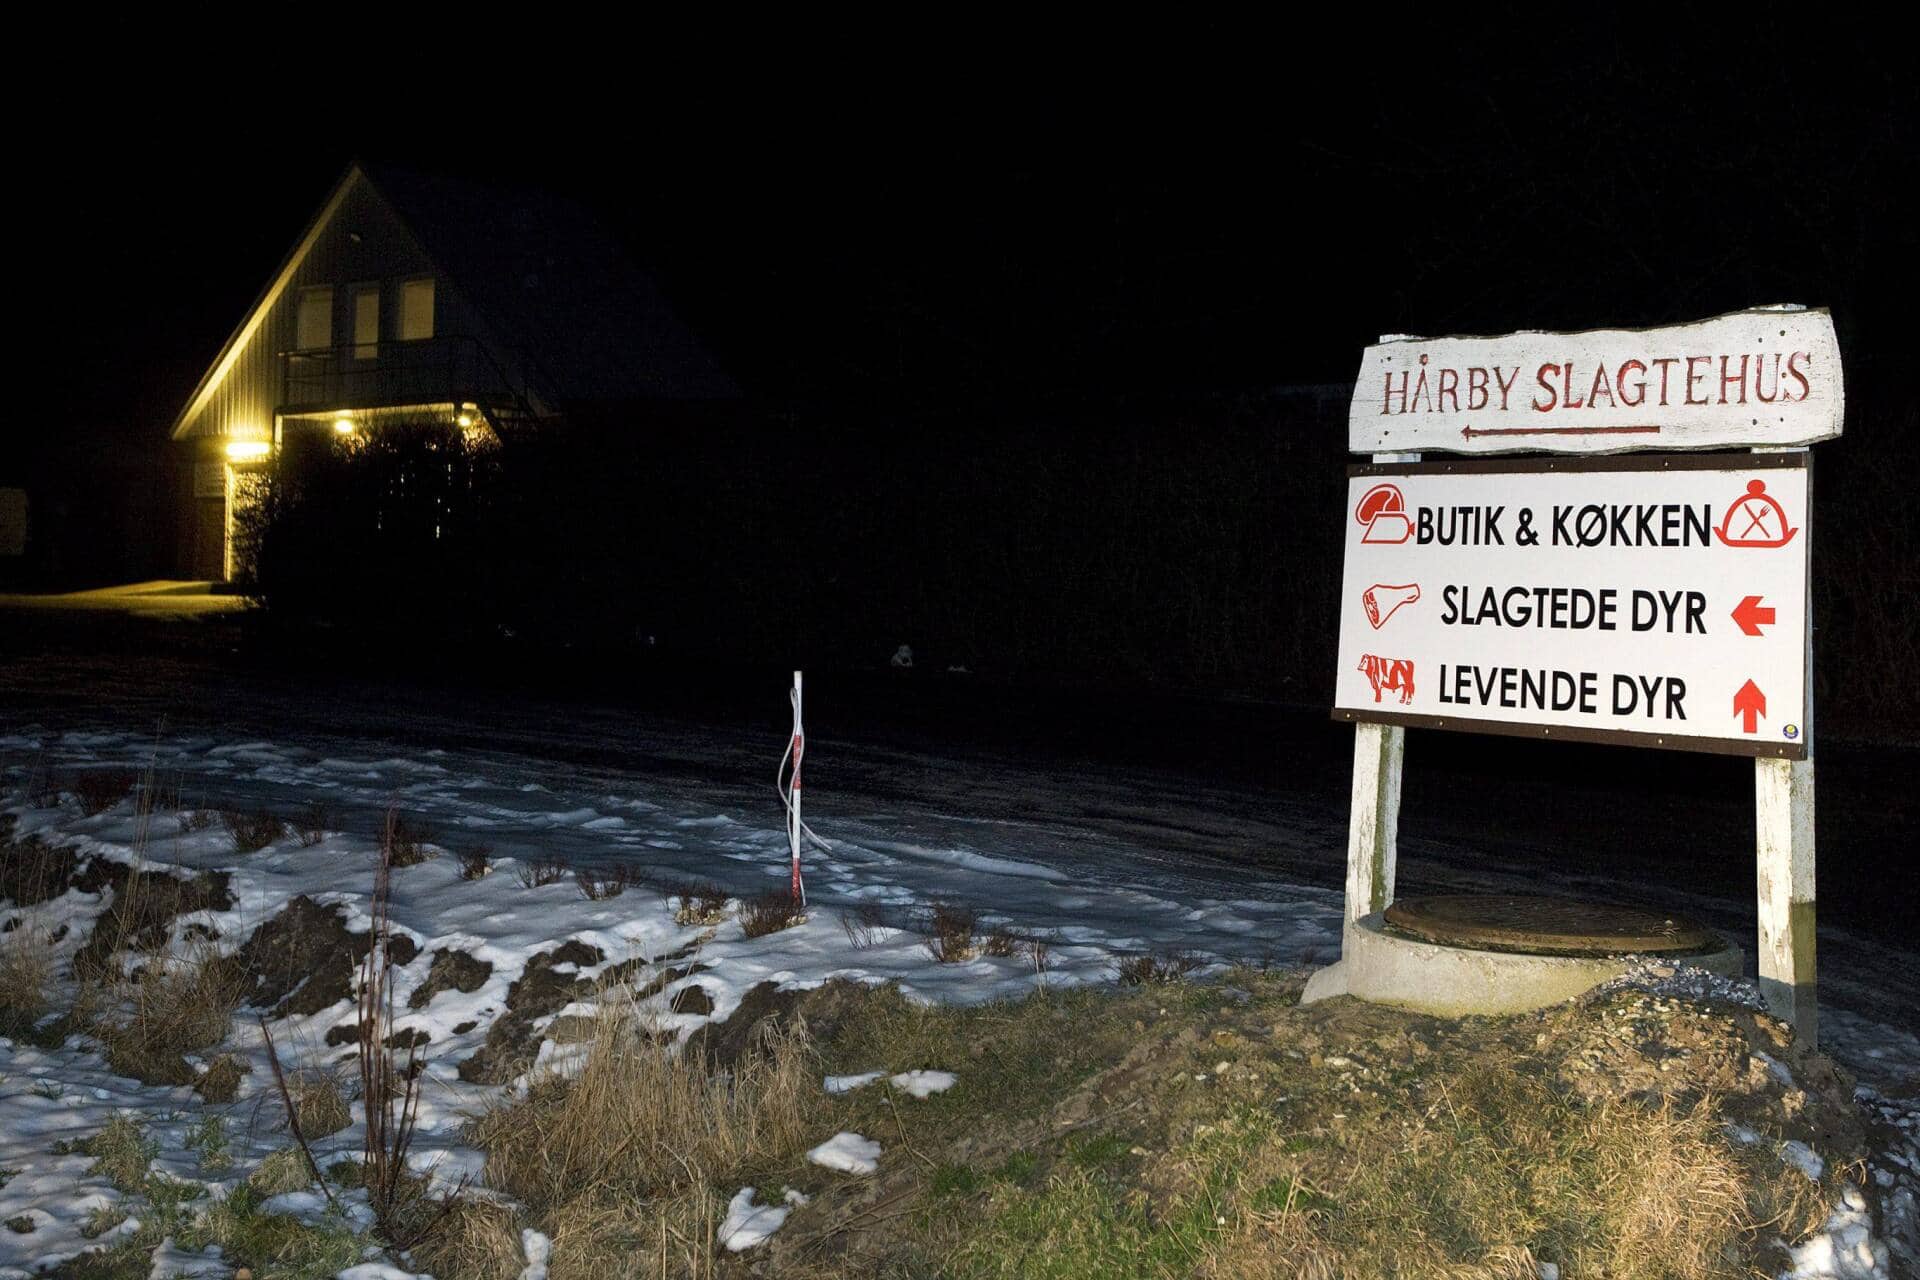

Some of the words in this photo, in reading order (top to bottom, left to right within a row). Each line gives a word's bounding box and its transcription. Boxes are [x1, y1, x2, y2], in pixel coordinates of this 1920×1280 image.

[1379, 353, 1521, 416] HÅRBY
[1531, 351, 1813, 413] SLAGTEHUS
[1416, 505, 1505, 546] BUTIK
[1515, 506, 1540, 546] &
[1552, 503, 1711, 549] KØKKEN
[1440, 584, 1617, 632] SLAGTEDE
[1631, 590, 1708, 635] DYR
[1439, 664, 1598, 714] LEVENDE
[1612, 674, 1688, 721] DYR
